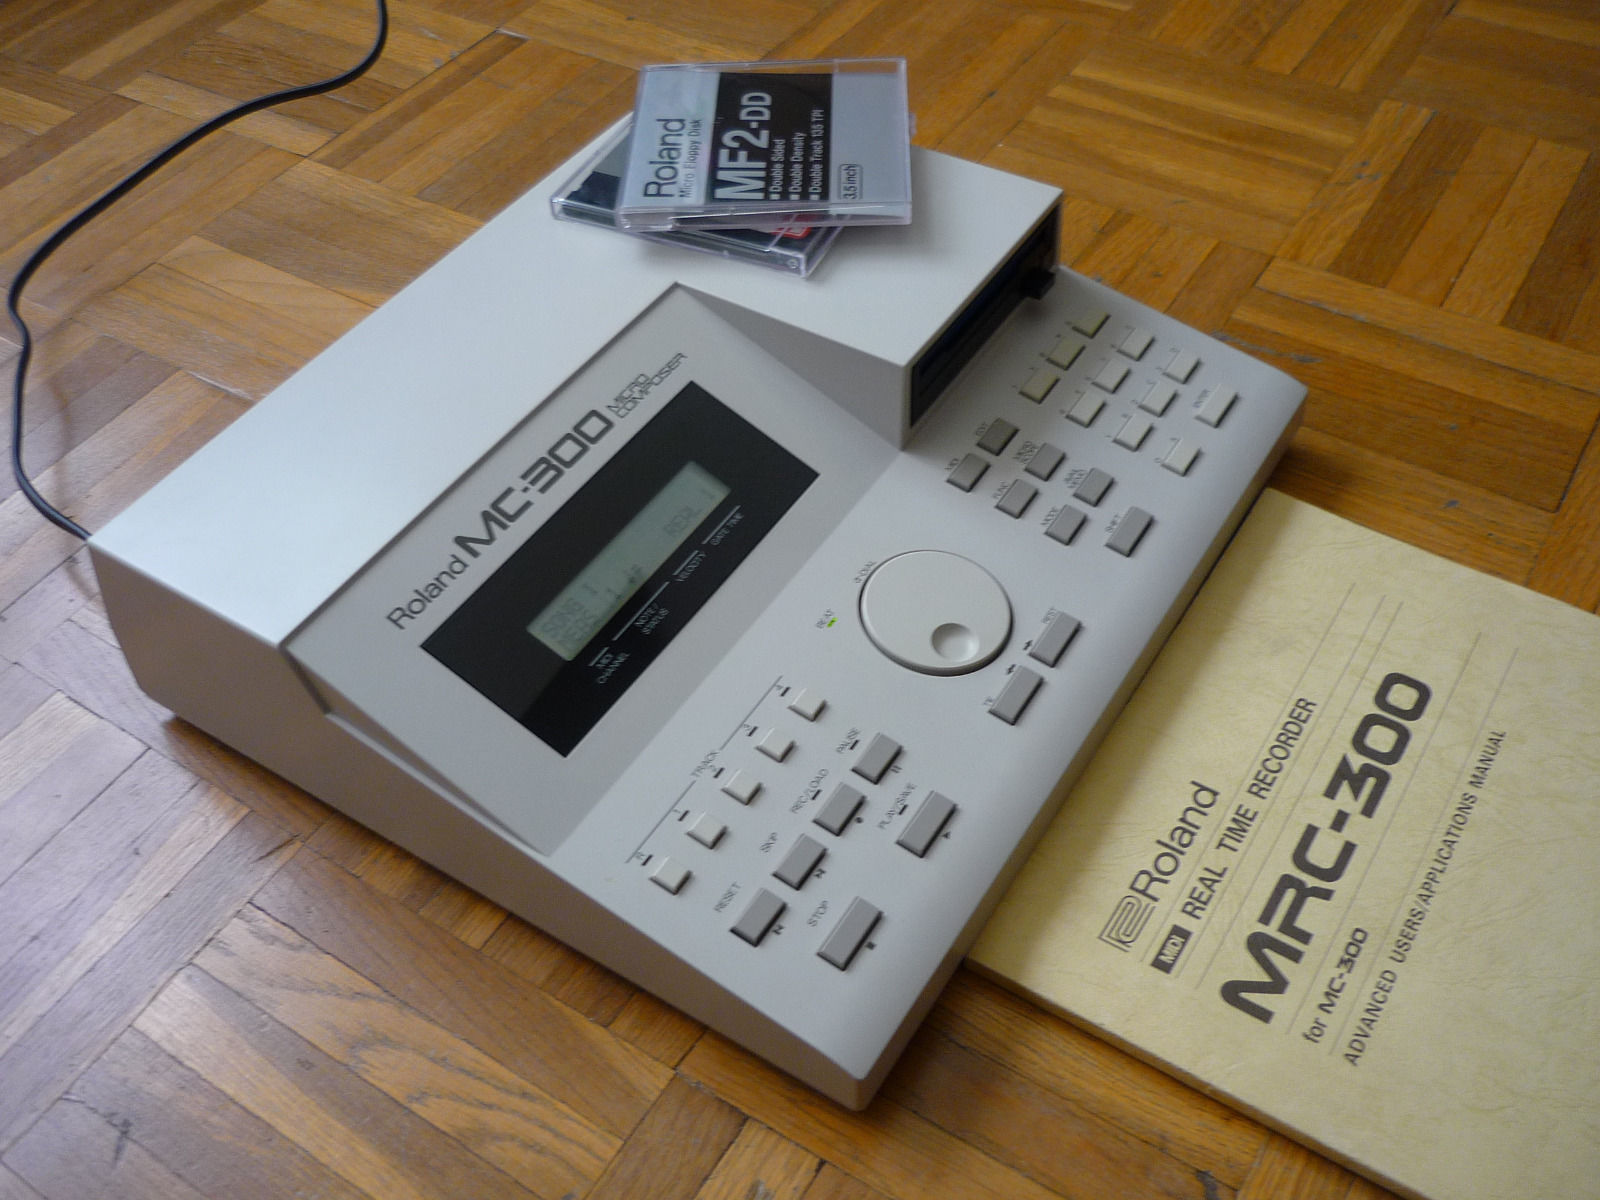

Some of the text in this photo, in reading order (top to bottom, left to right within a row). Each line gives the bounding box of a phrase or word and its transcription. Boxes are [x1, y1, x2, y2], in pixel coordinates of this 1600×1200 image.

[713, 92, 773, 200] MF2-DD
[809, 140, 824, 162] Track
[811, 109, 825, 122] TPI
[643, 118, 686, 198] Roland
[677, 119, 702, 198] Micro Floppy Disk
[768, 138, 786, 193] Double Sided
[788, 131, 808, 193] Double Density
[808, 163, 824, 193] Double
[606, 373, 650, 414] MICRO
[615, 352, 689, 419] COMPOSER
[386, 408, 615, 631] Roland MC-300
[1129, 779, 1221, 902] Roland
[1157, 697, 1317, 966] MIDI REAL TIME RECORDER
[1220, 672, 1433, 1025] MRC-300
[1343, 729, 1508, 1067] ADVANCED USERS/APPLICATIONS MANUAL
[1302, 927, 1369, 1044] for MC-300
